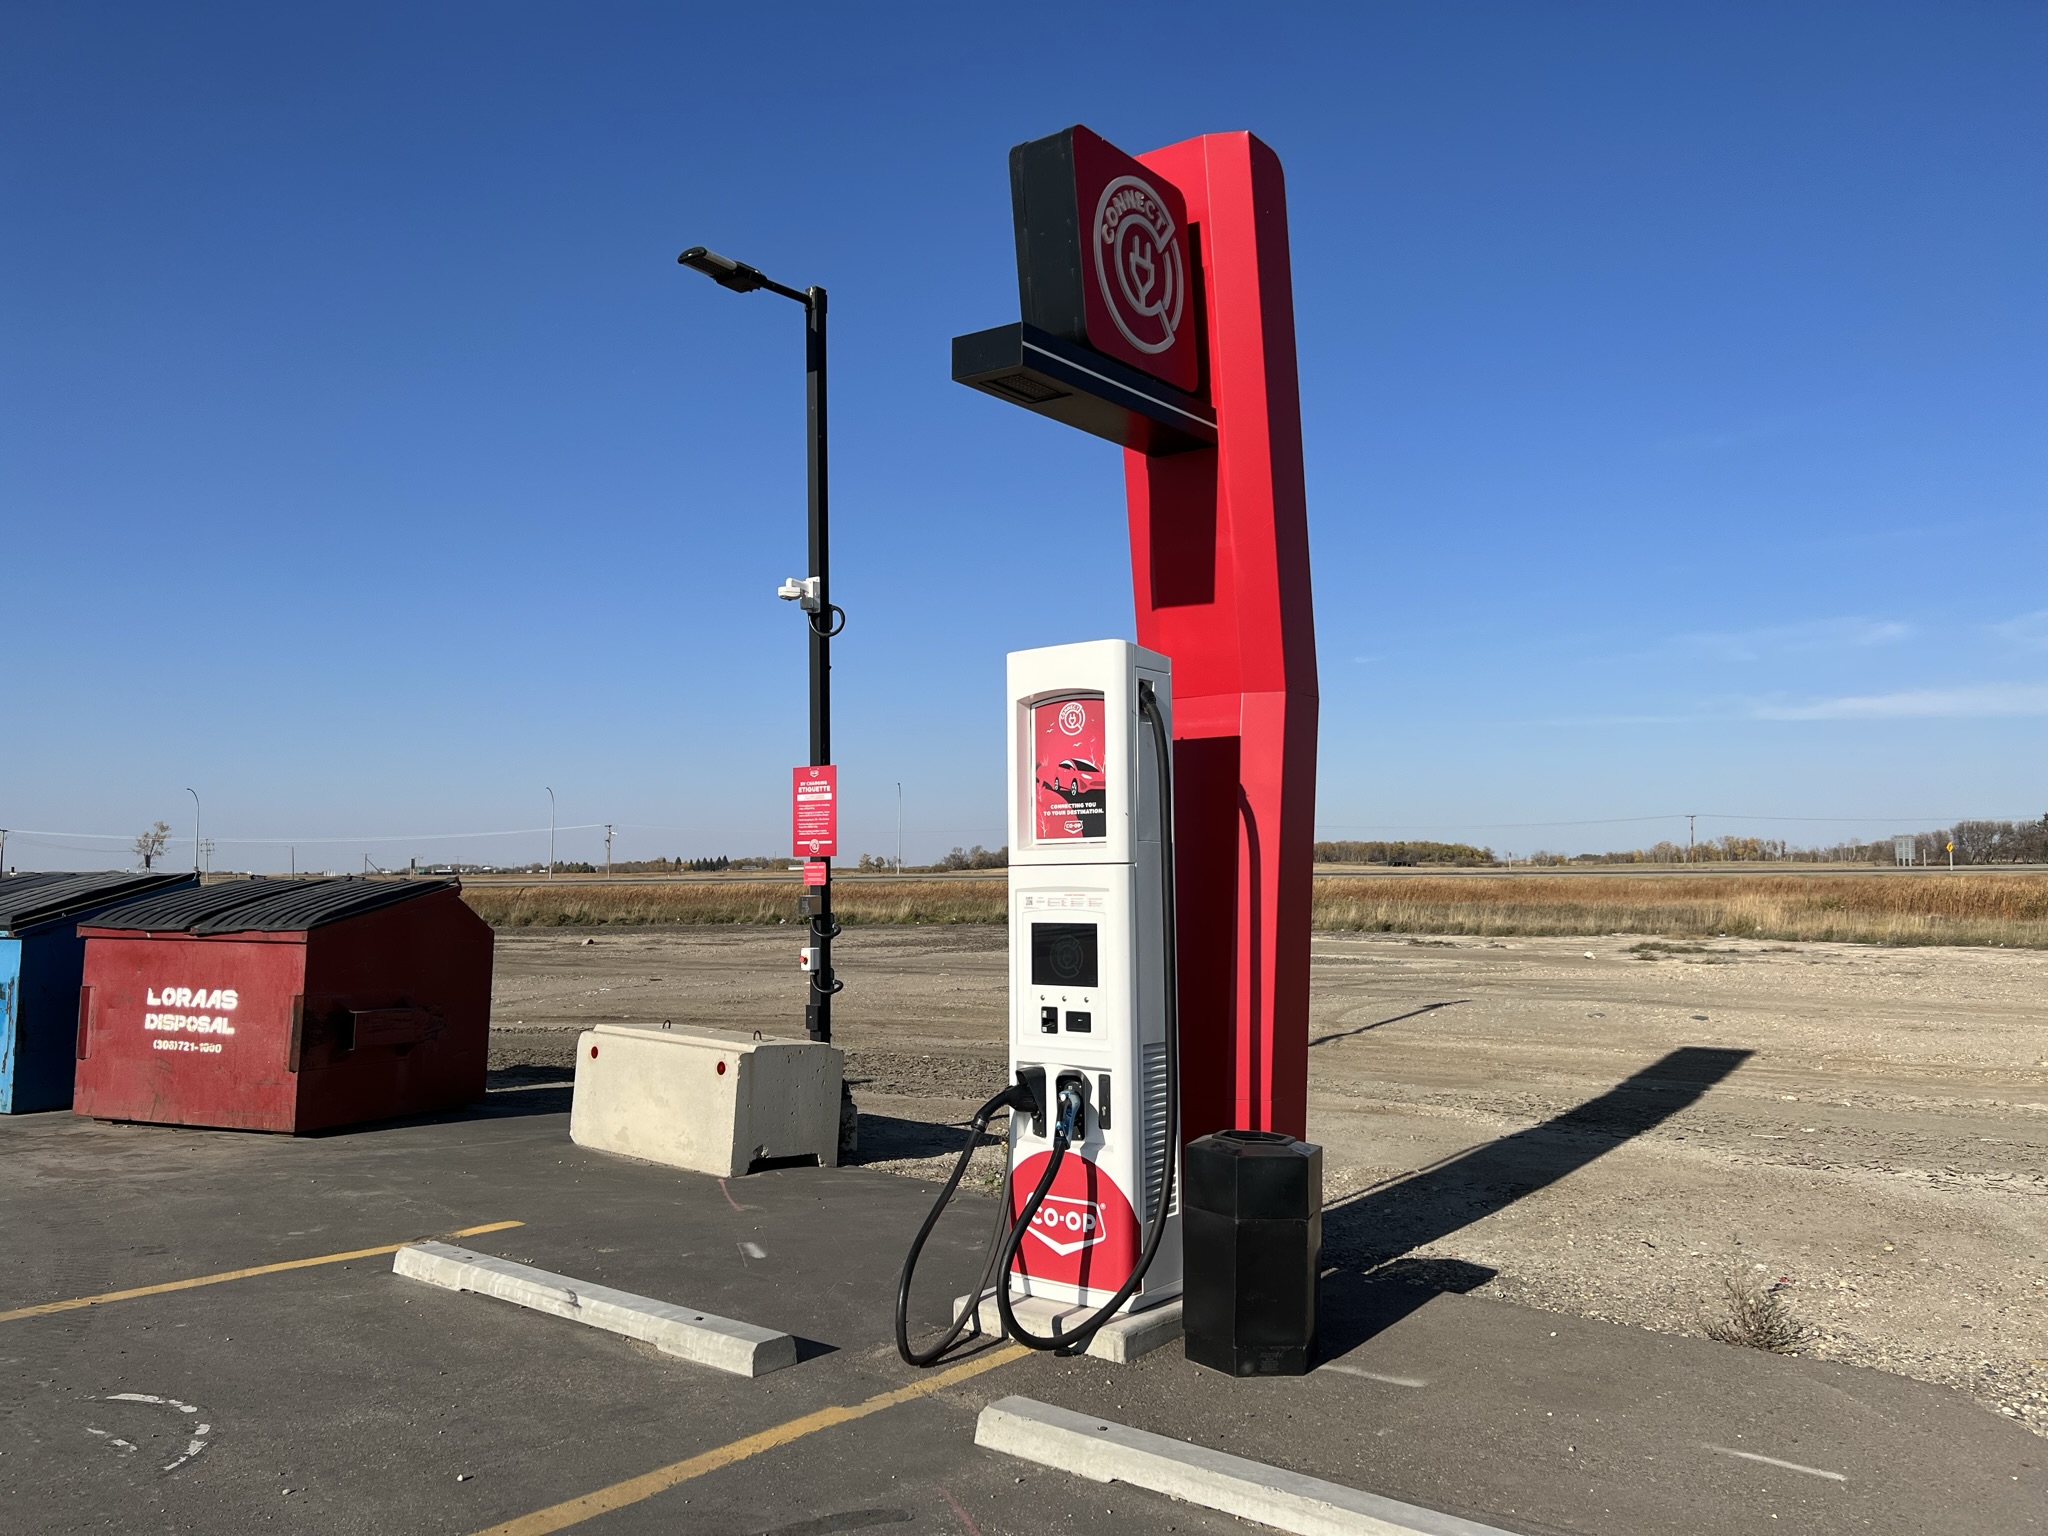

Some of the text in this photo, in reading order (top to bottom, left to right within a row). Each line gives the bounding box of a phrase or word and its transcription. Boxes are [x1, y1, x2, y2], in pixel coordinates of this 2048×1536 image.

[1101, 189, 1166, 245] CONNECT
[798, 785, 831, 793] ETIQUETTE
[1066, 808, 1104, 816] DESTINATION.
[146, 987, 238, 1010] LORAAS
[144, 1013, 236, 1035] DISPOSAL
[1031, 1207, 1096, 1232] CO-OP
